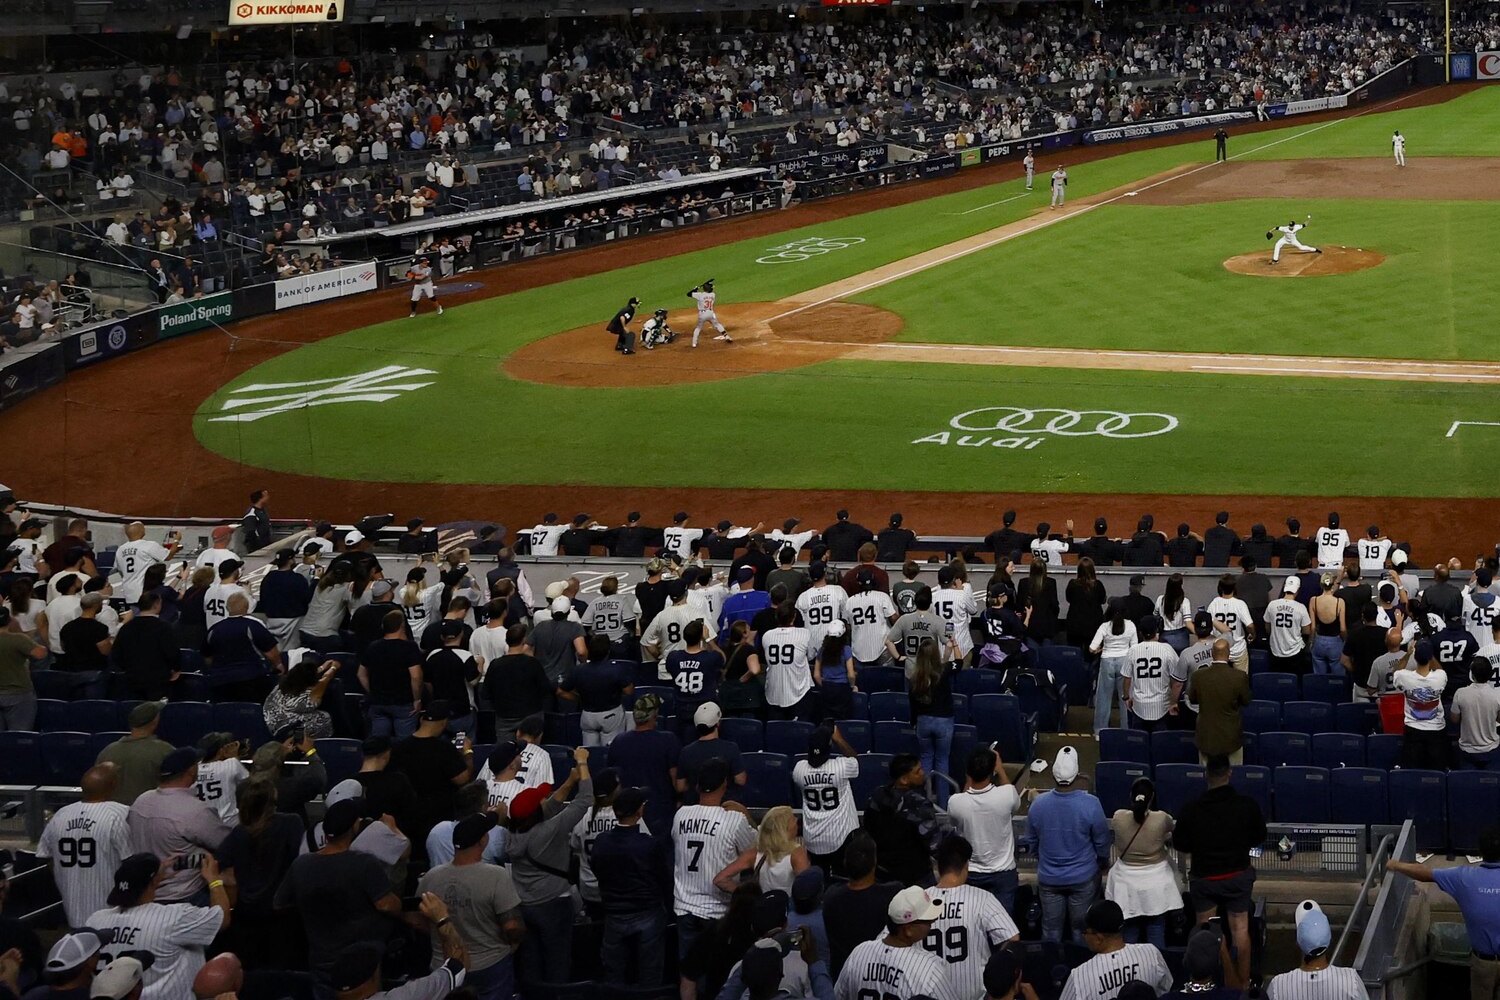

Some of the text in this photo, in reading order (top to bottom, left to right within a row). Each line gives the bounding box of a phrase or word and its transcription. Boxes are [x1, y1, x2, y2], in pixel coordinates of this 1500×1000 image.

[256, 4, 324, 16] KIKKOMAN
[988, 145, 1009, 158] PEPSI
[277, 277, 357, 299] BANK OF AMERICA
[160, 302, 232, 331] Poland Spring
[911, 431, 1046, 450] Audi
[532, 531, 548, 545] 67
[665, 534, 682, 549] 75
[1322, 532, 1339, 546] 95
[1365, 545, 1380, 559] 19
[206, 598, 226, 617] 45
[810, 594, 831, 606] JUDGE
[934, 600, 953, 619] 15
[595, 613, 619, 630] 25
[808, 605, 833, 625] 99
[852, 605, 876, 626] 24
[1275, 612, 1293, 629] 25
[769, 644, 795, 665] 99
[1440, 639, 1468, 663] 27
[680, 661, 701, 670] RIZZO
[1136, 657, 1162, 679] 22
[675, 671, 704, 694] 48
[803, 773, 835, 787] JUDGE
[803, 786, 840, 812] 99
[66, 817, 97, 832] JUDGE
[679, 818, 721, 837] MANTLE
[58, 837, 97, 869] 99
[686, 840, 705, 872] 7
[862, 962, 904, 989] JUDGE
